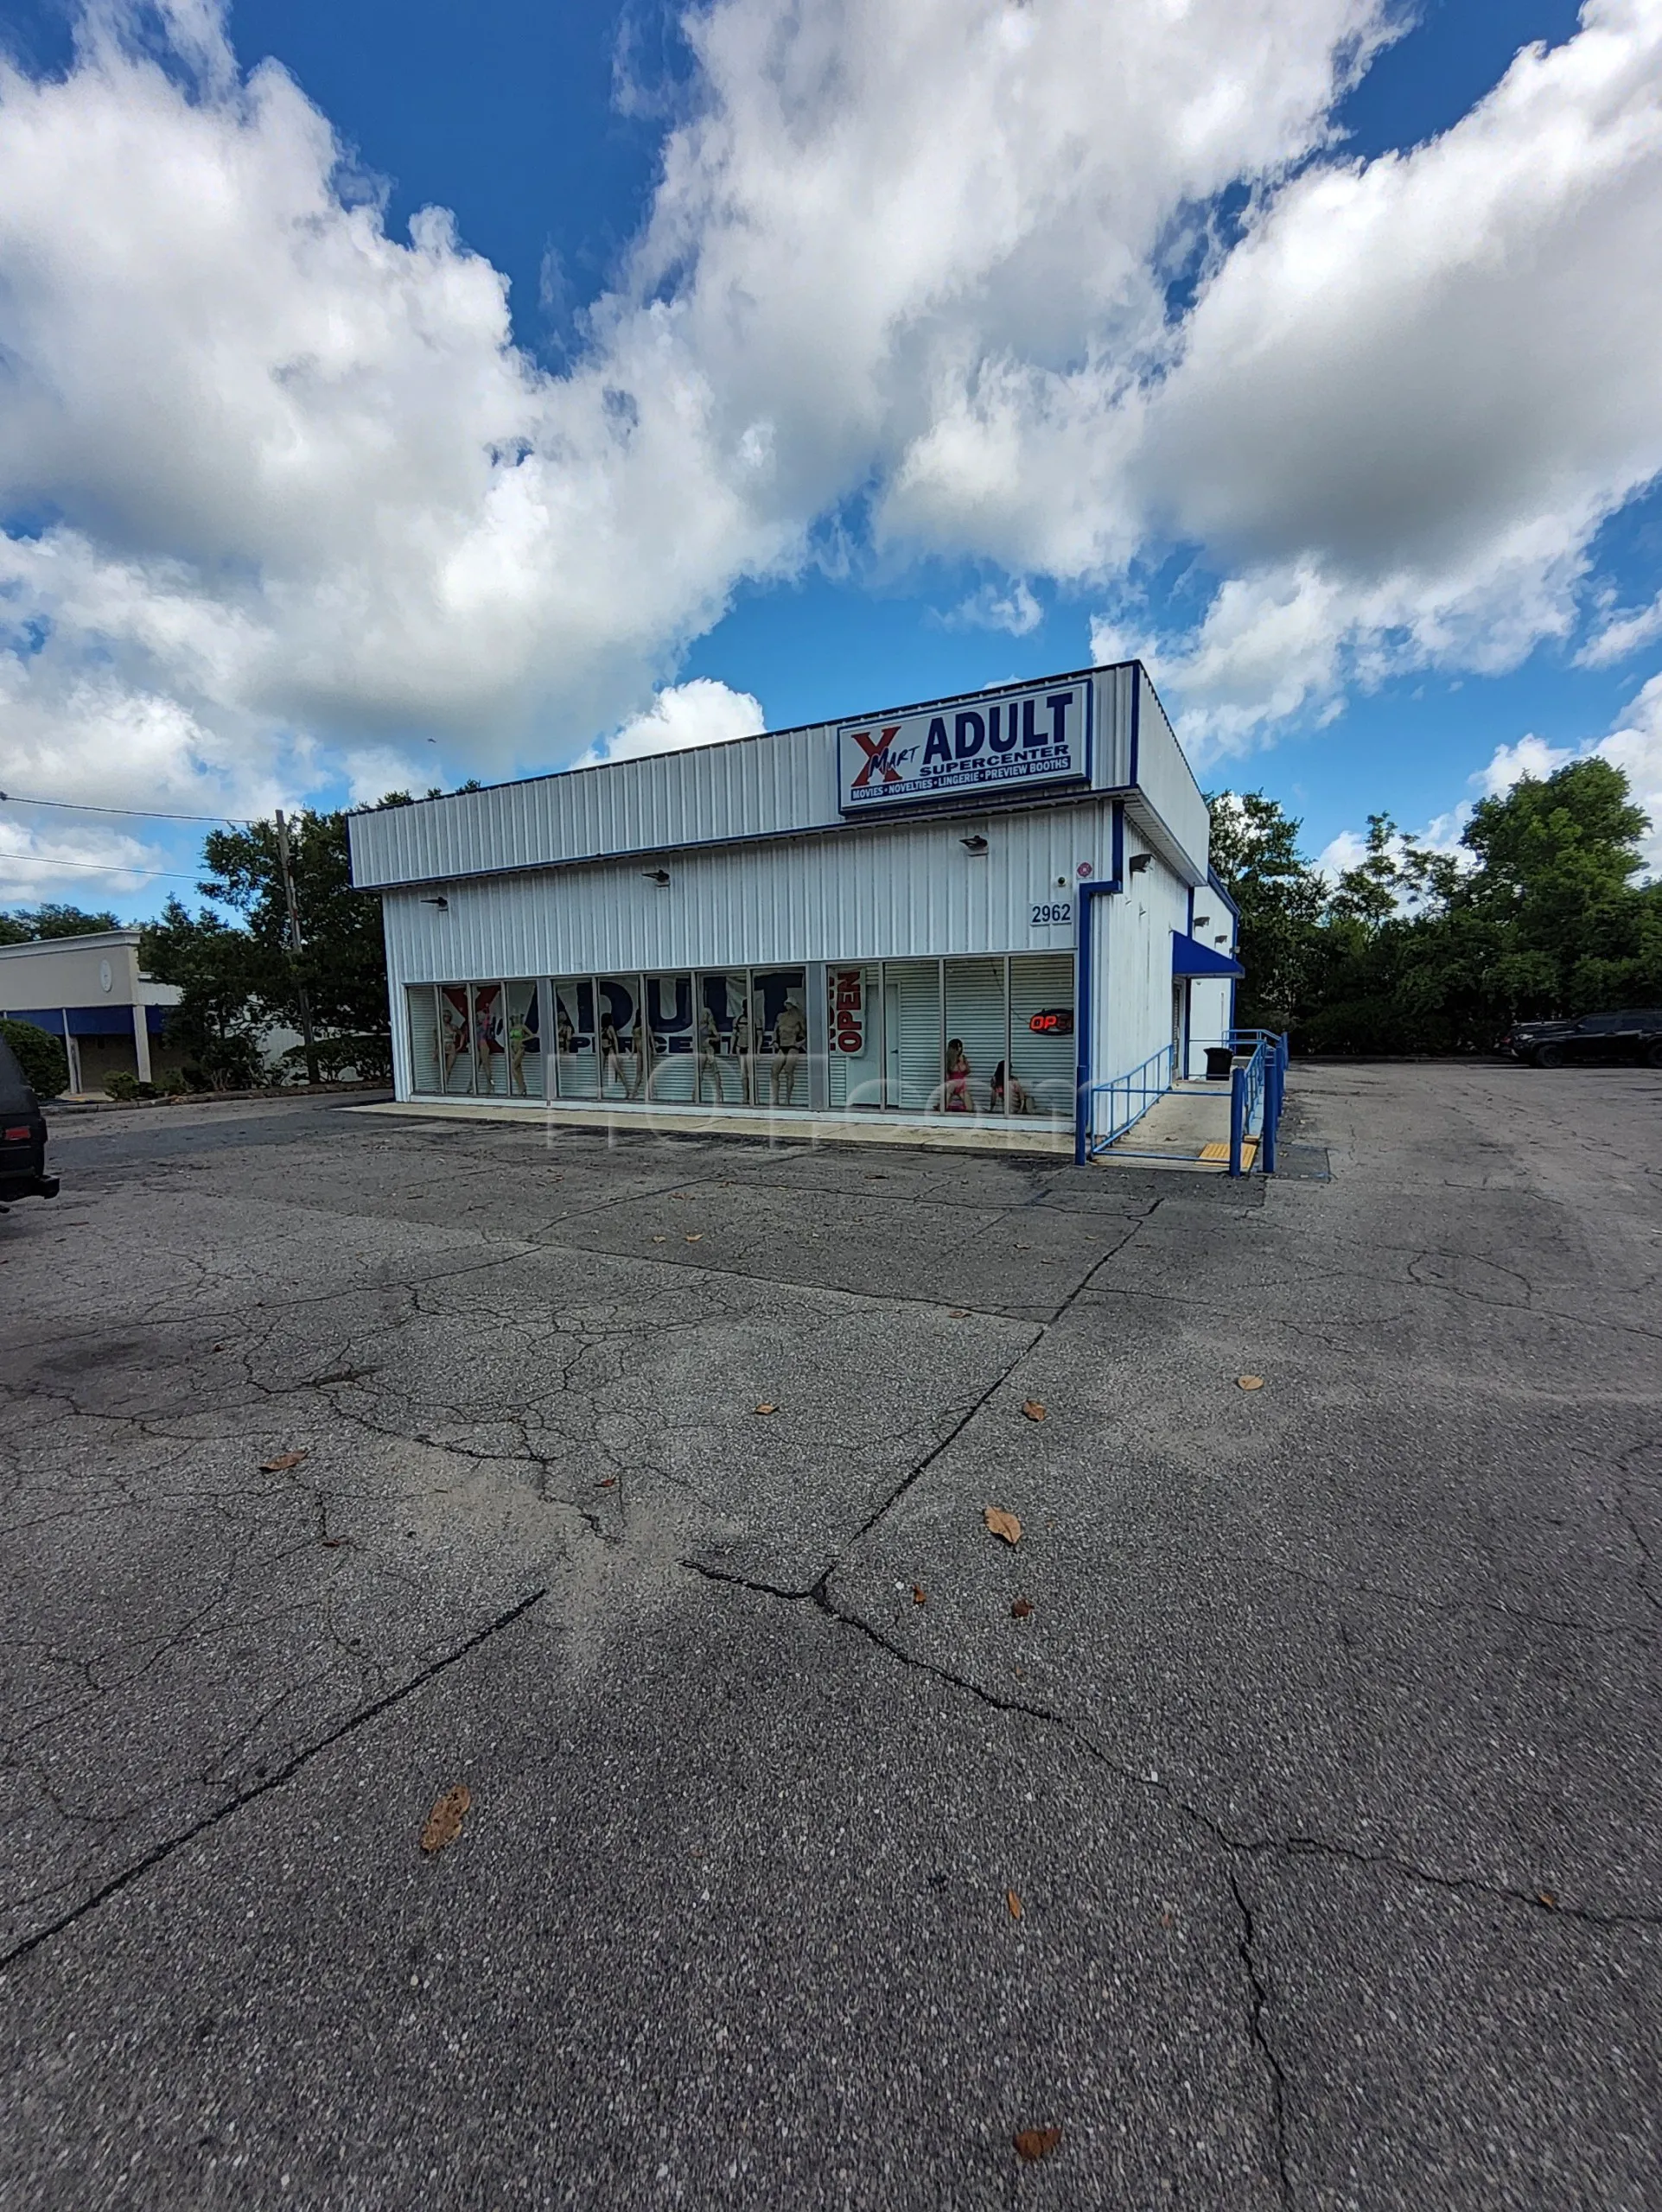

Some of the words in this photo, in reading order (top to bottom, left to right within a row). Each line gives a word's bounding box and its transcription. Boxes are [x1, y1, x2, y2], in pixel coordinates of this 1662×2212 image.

[850, 726, 902, 787] X
[922, 692, 1073, 766] ADULT
[852, 786, 883, 799] MOVIES
[888, 779, 933, 794] NOVELTIES
[938, 772, 979, 787] LINGERIE
[984, 764, 1028, 780] PREVIEW
[1029, 758, 1068, 773] BOOTHS
[919, 744, 1070, 777] SUPERCENTER
[1032, 903, 1071, 924] 2962
[836, 970, 863, 1053] OPEN
